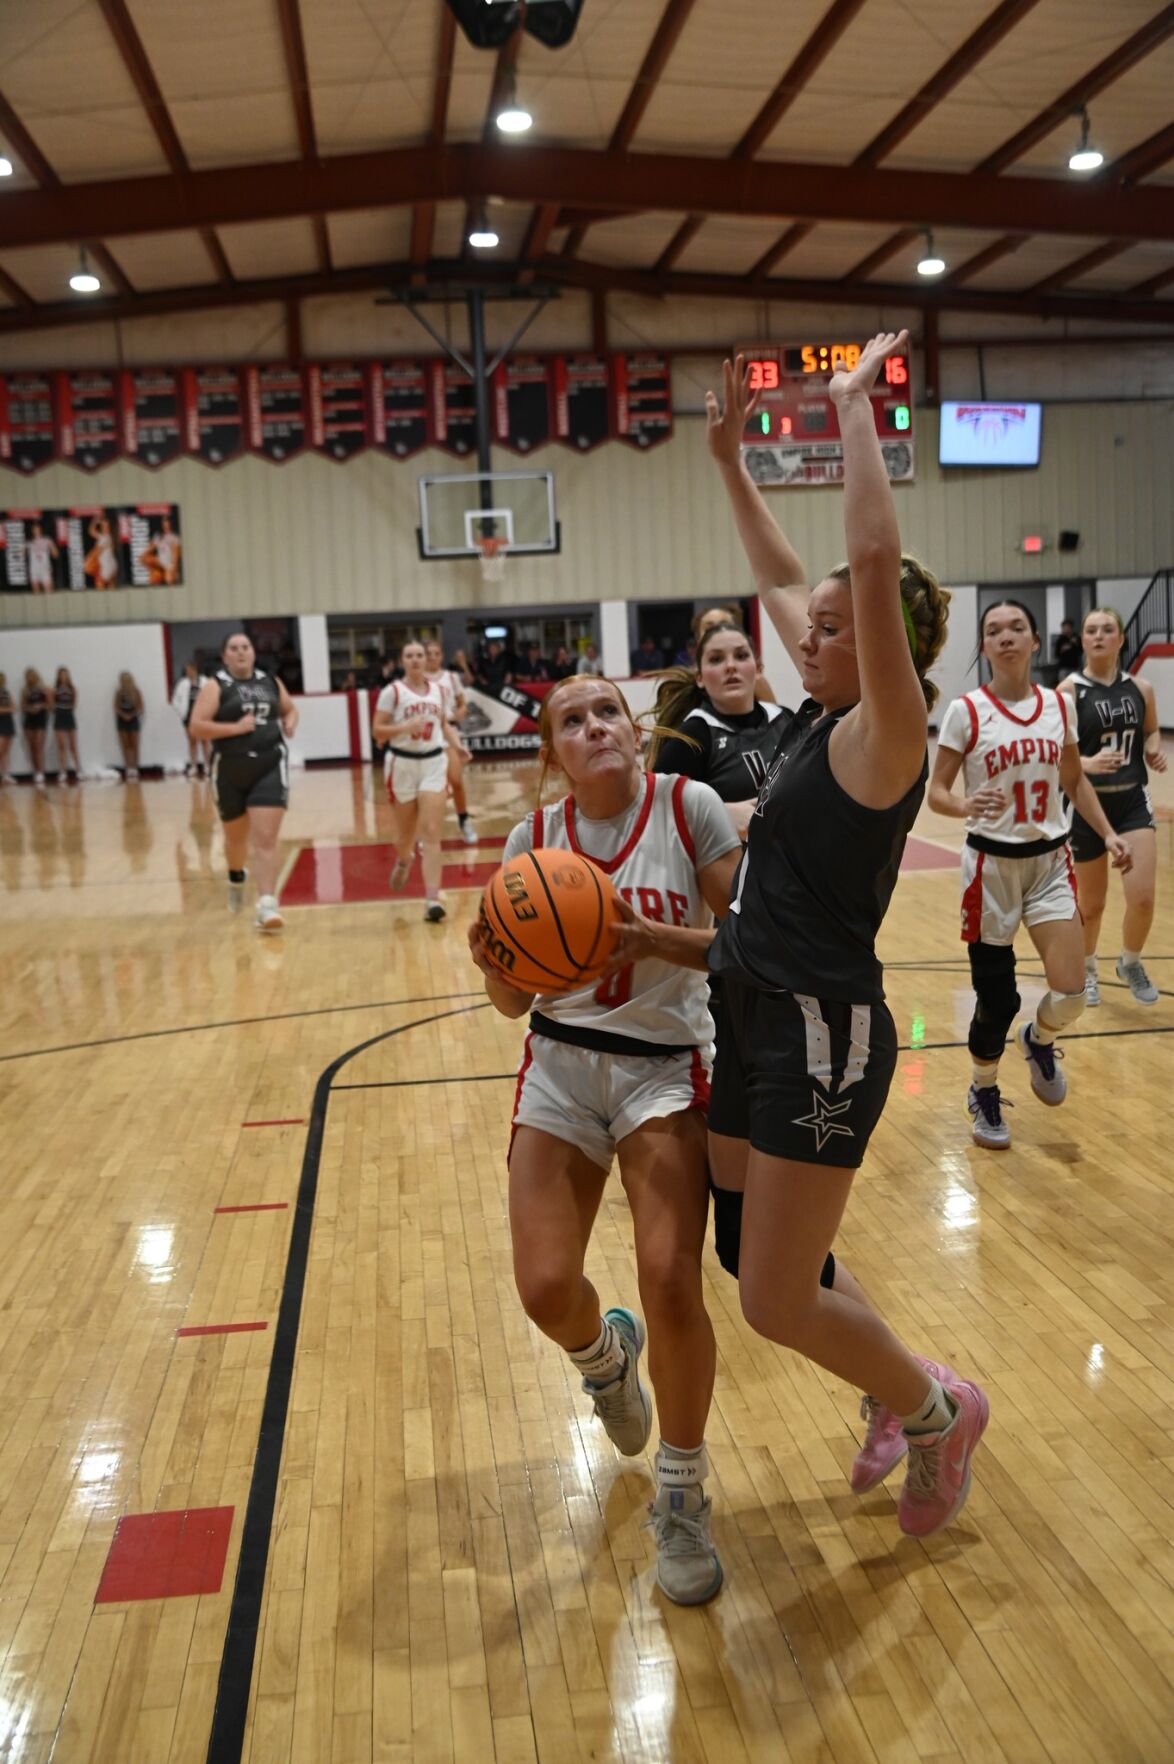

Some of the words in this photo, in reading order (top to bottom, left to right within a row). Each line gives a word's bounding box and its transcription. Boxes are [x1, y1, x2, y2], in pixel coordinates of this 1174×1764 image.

[801, 345, 861, 373] 5:08
[885, 357, 907, 384] 16
[750, 361, 779, 389] 33
[761, 412, 770, 435] 1
[895, 405, 910, 430] 0
[500, 686, 528, 707] OF
[1095, 696, 1138, 728] V-A
[461, 733, 542, 752] ULLDOGS
[984, 738, 1062, 779] EMPIR
[1013, 780, 1049, 823] 13
